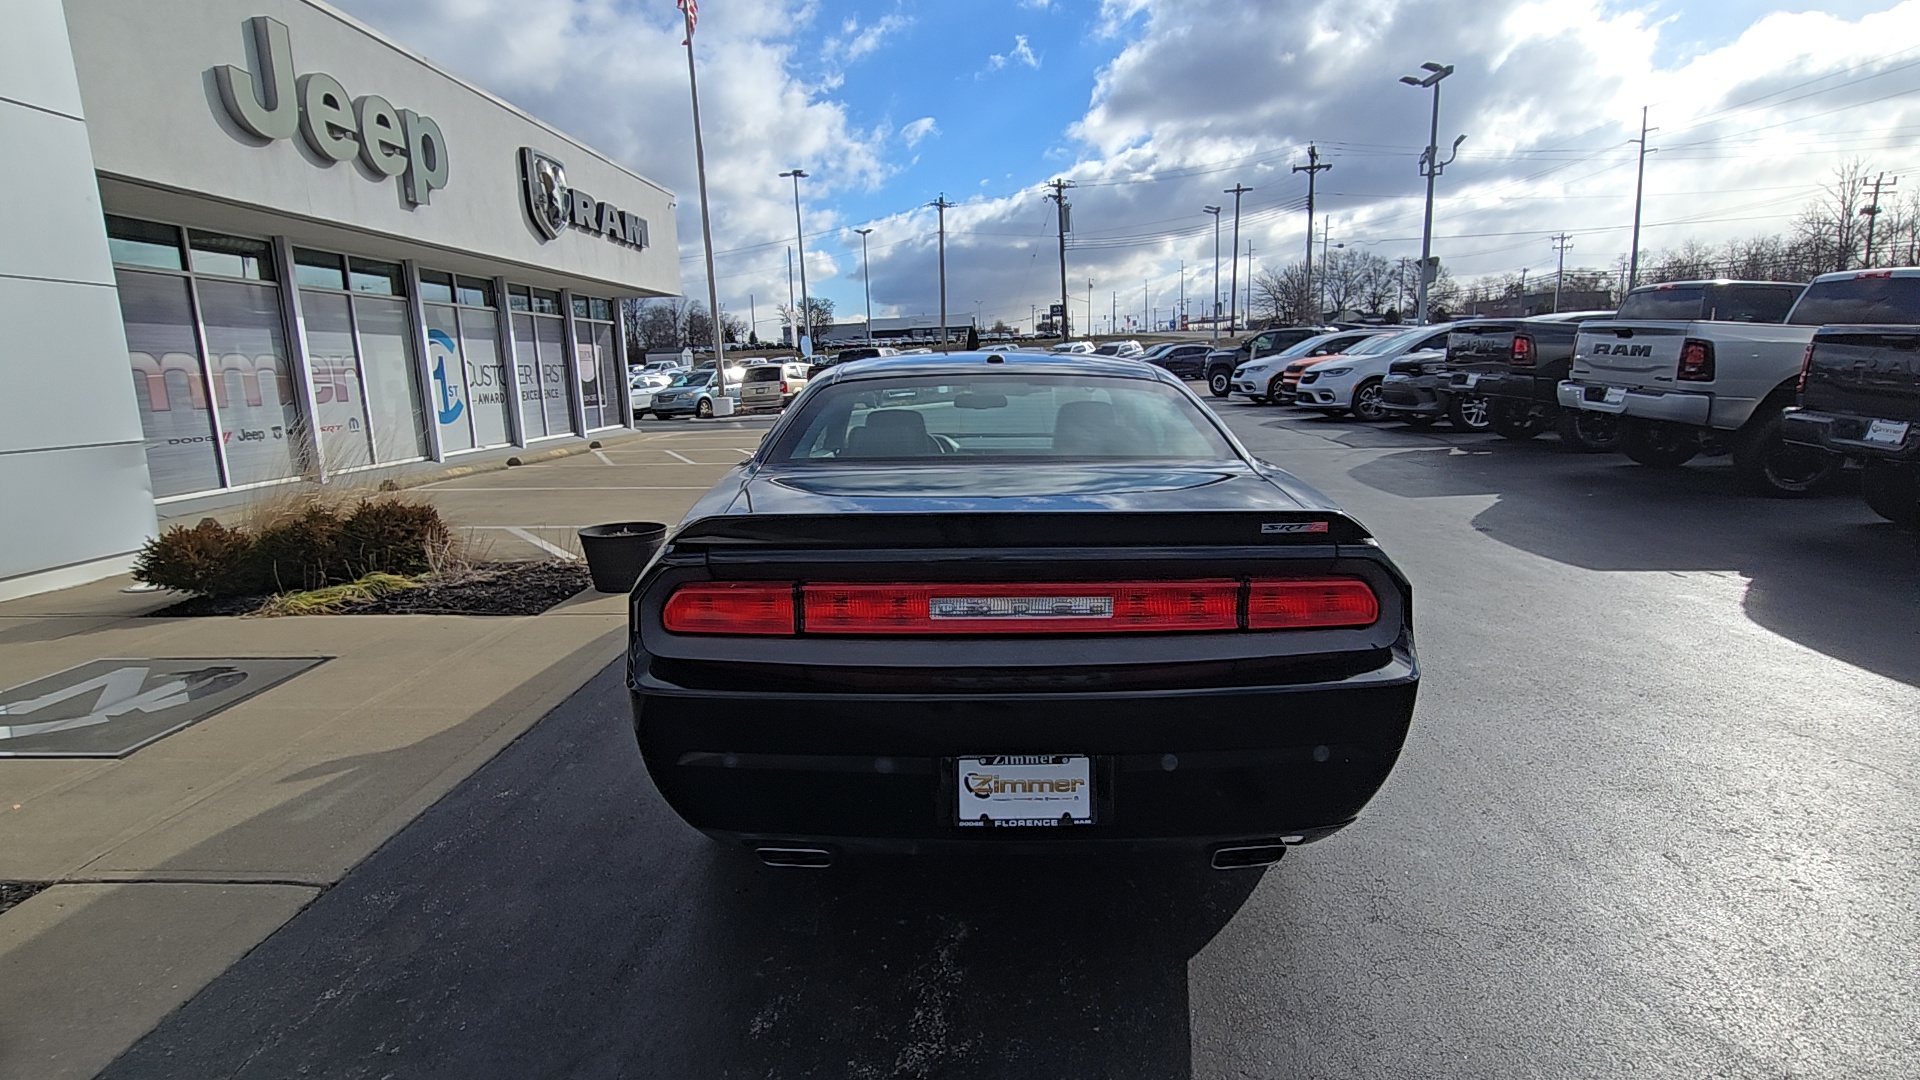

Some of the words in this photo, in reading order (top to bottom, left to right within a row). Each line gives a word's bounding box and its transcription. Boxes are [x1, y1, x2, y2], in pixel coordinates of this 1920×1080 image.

[212, 15, 449, 206] Jeep
[568, 188, 650, 250] RAM
[1593, 343, 1652, 357] RAM
[467, 360, 534, 387] CUSTOER
[537, 363, 567, 384] IRST
[478, 392, 505, 404] AWARD
[522, 388, 560, 401] EXCEENCE
[238, 429, 265, 442] Jeep
[320, 424, 343, 433] SRT
[168, 436, 216, 445] DODG
[992, 755, 1056, 765] Zimmer
[972, 774, 1085, 795] Zimmer
[994, 819, 1059, 828] FLORENCE
